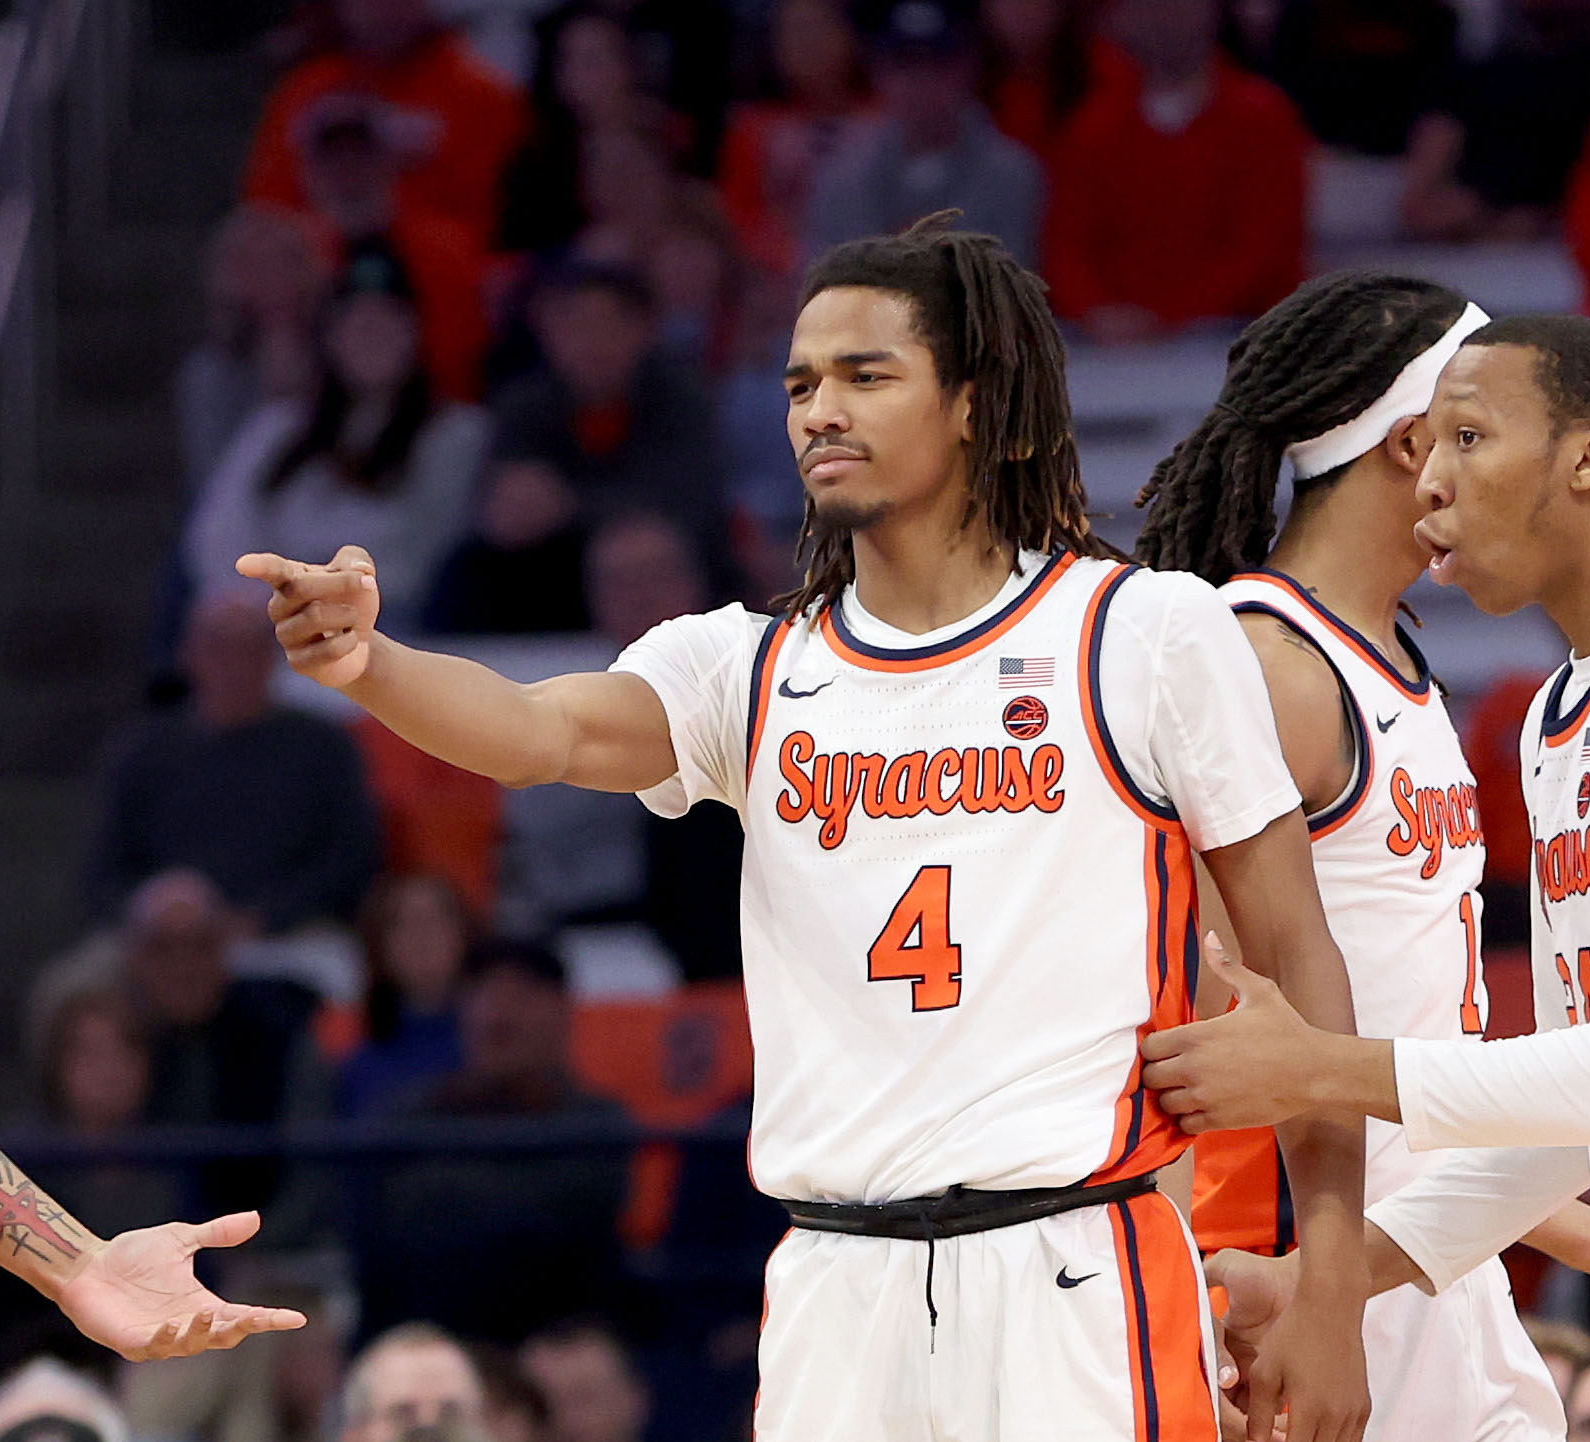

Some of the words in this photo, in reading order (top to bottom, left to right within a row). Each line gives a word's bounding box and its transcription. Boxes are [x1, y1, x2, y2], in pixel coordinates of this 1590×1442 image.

[776, 731, 1065, 850] Syracuse
[867, 865, 962, 1012] 4
[1460, 891, 1484, 1034] 1
